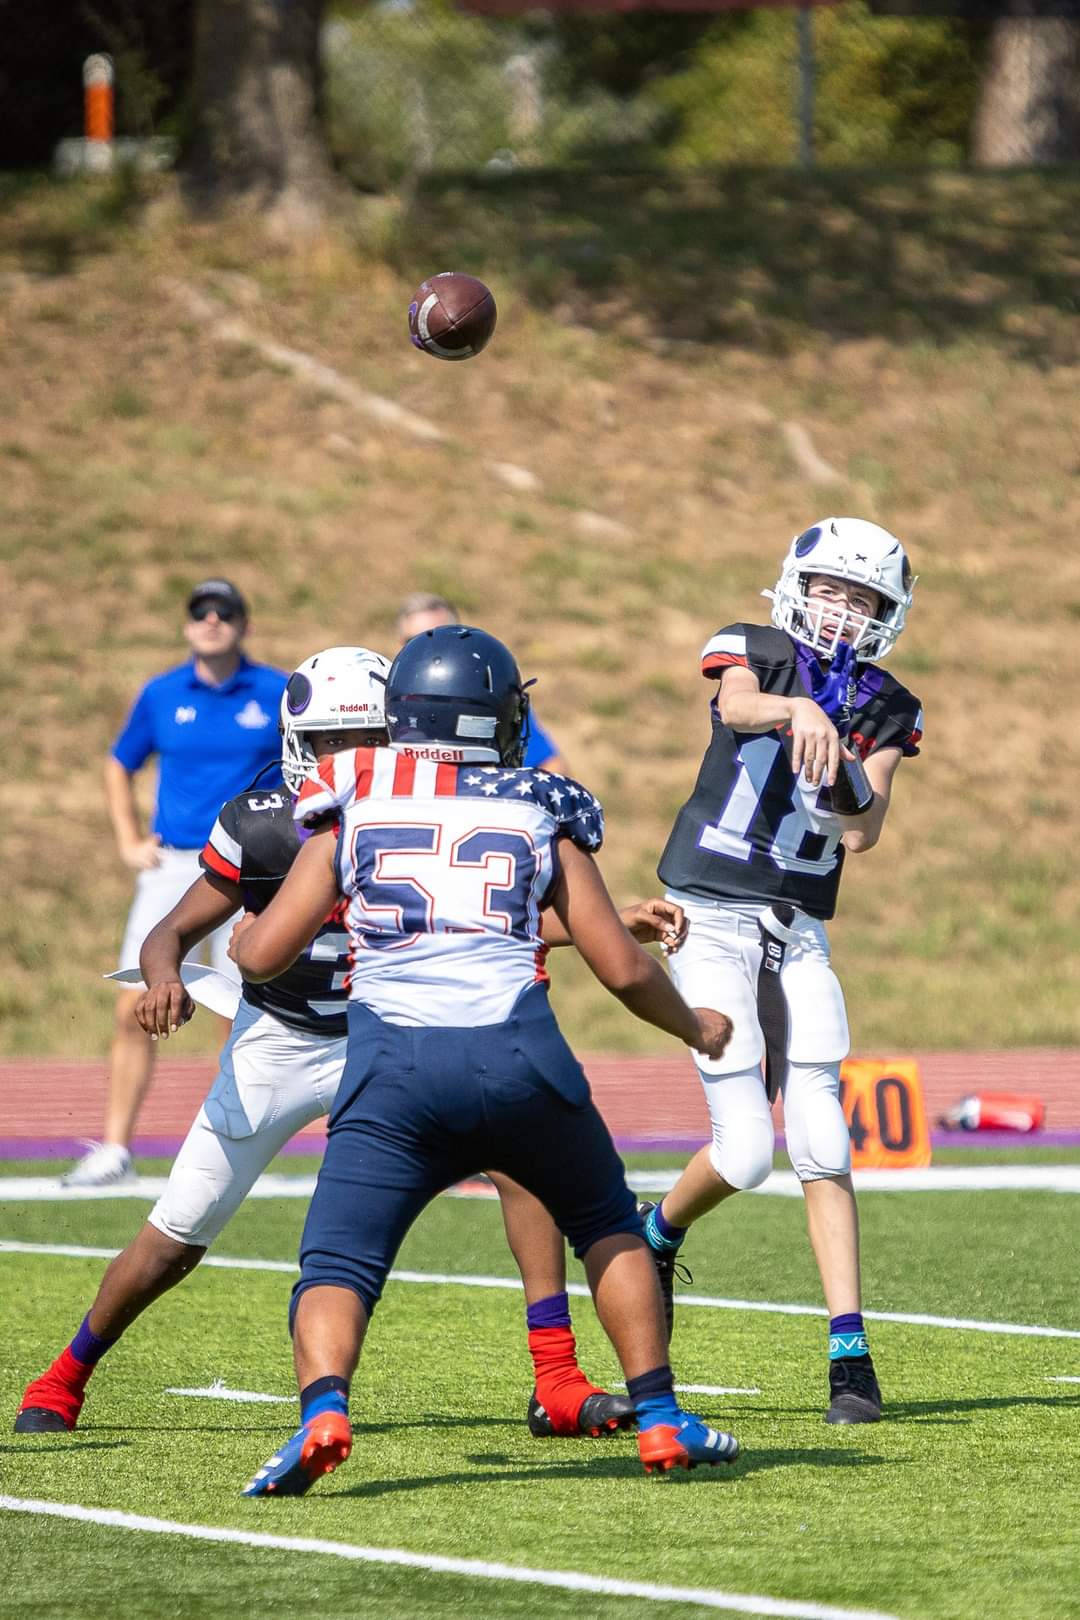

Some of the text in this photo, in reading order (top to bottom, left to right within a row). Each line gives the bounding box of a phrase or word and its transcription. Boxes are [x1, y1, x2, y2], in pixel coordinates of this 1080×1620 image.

[339, 703, 369, 713] Riddell
[404, 747, 465, 762] Riddell
[698, 735, 839, 877] 18
[350, 822, 542, 948] 53
[839, 1078, 912, 1153] 40
